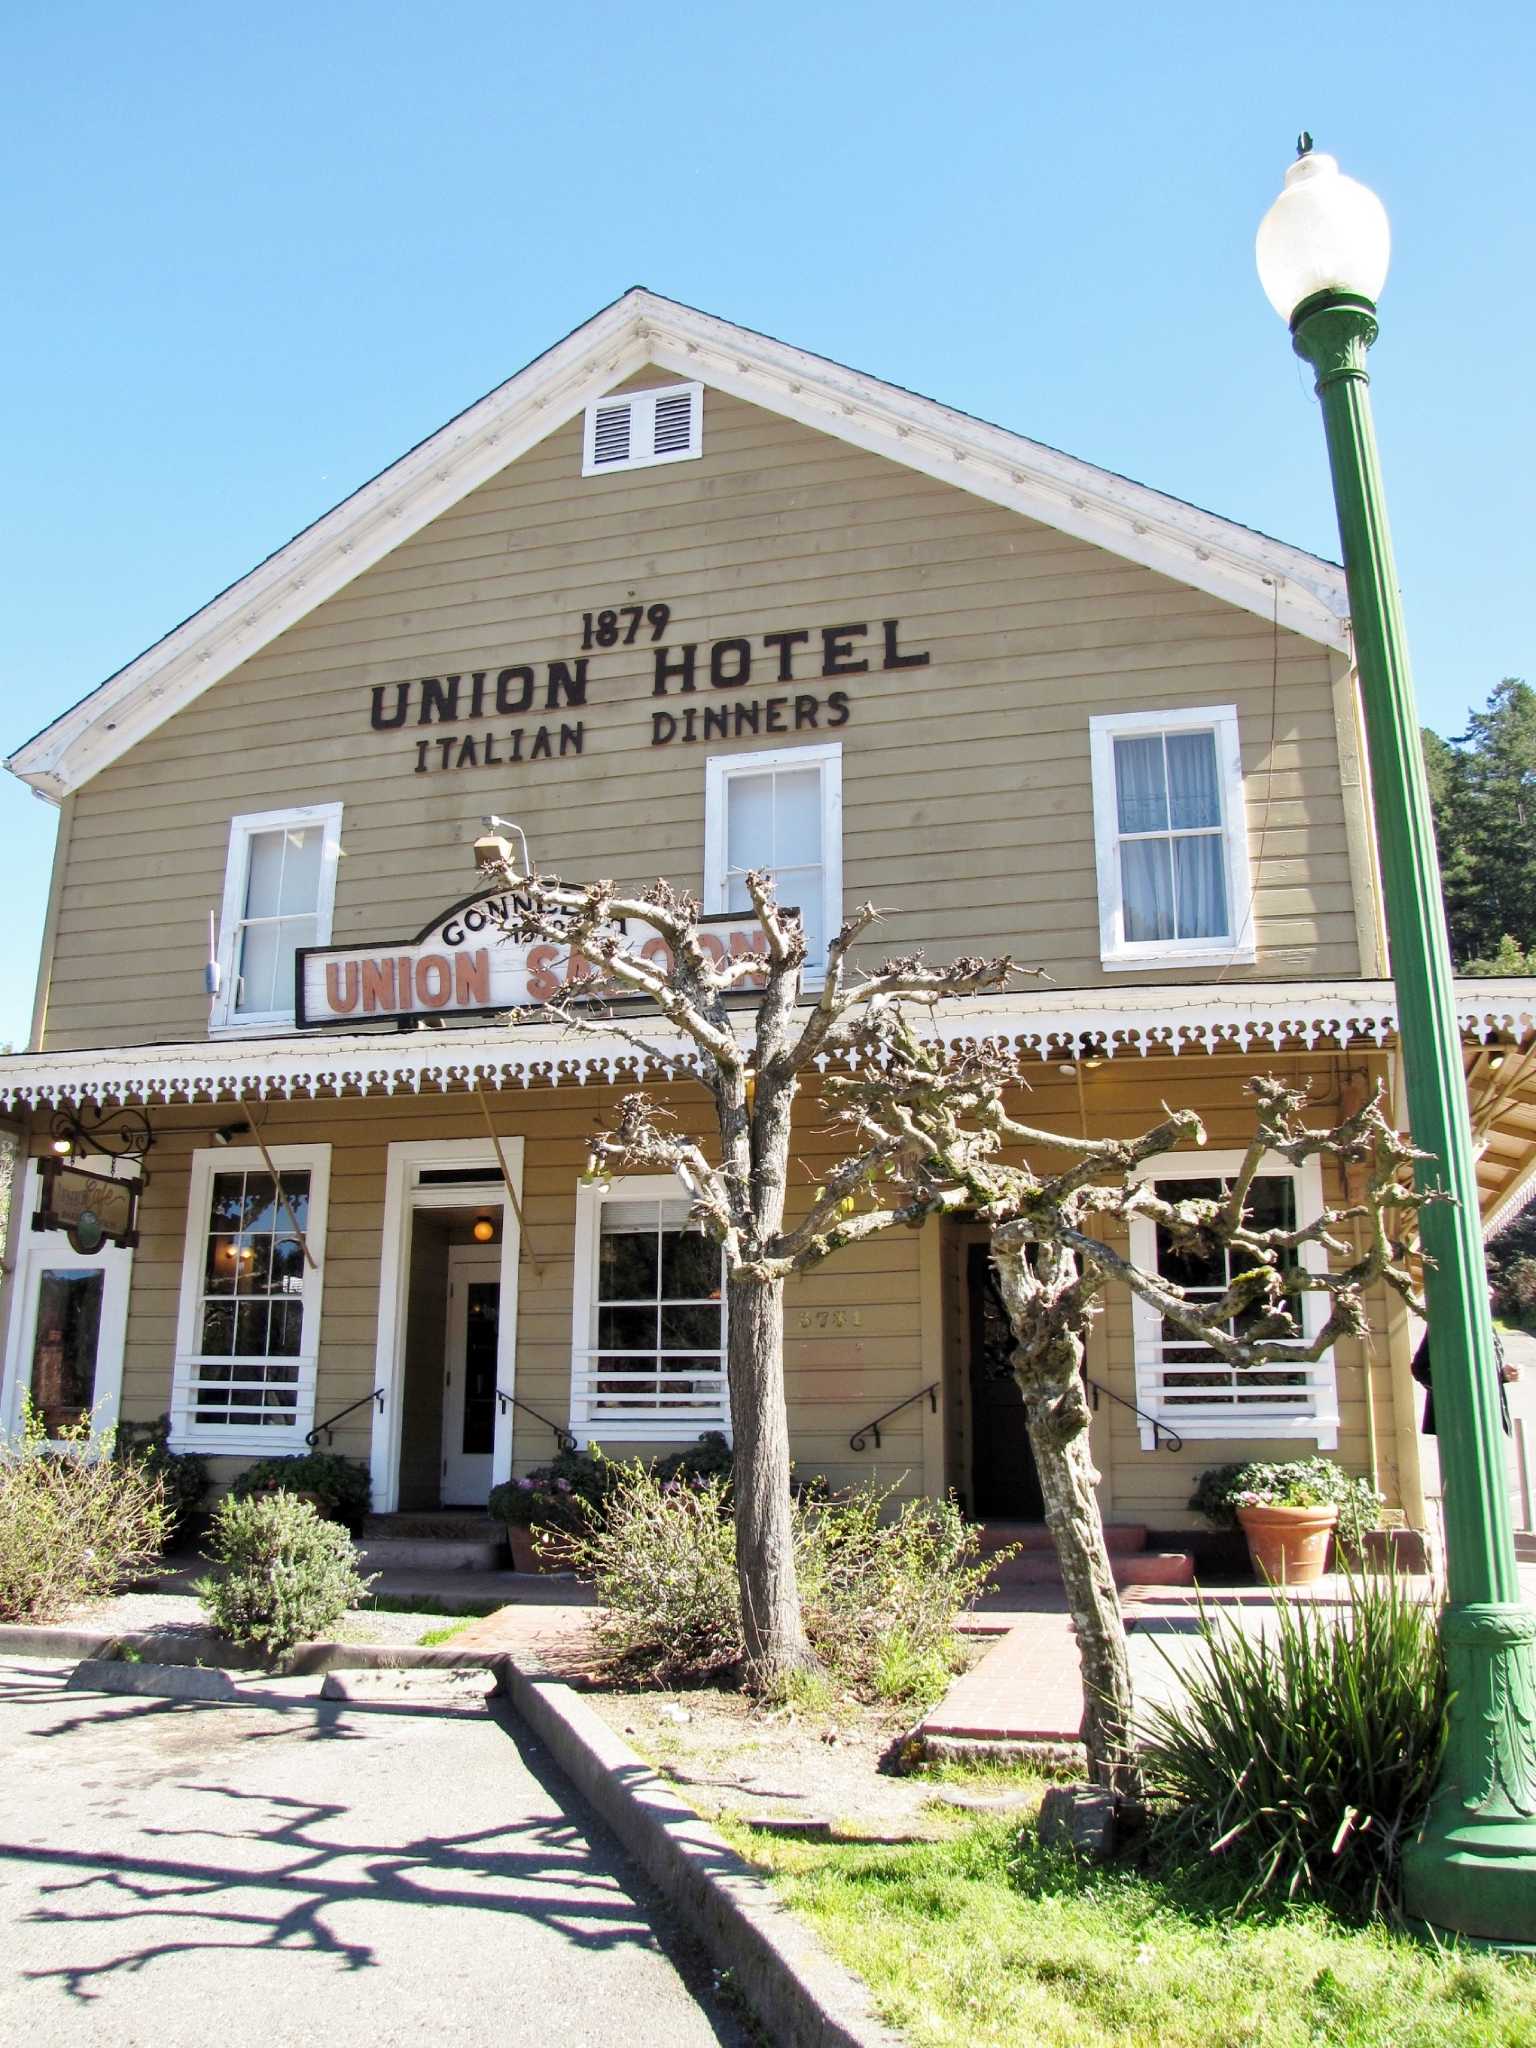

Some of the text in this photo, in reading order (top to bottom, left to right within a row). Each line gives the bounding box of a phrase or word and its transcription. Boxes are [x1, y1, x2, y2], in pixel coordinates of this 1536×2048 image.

[581, 603, 670, 650] 1879
[371, 620, 930, 731] UNION HOTEL
[414, 691, 850, 773] ITALIAN DINNERS
[325, 930, 768, 1013] UNION SAOON
